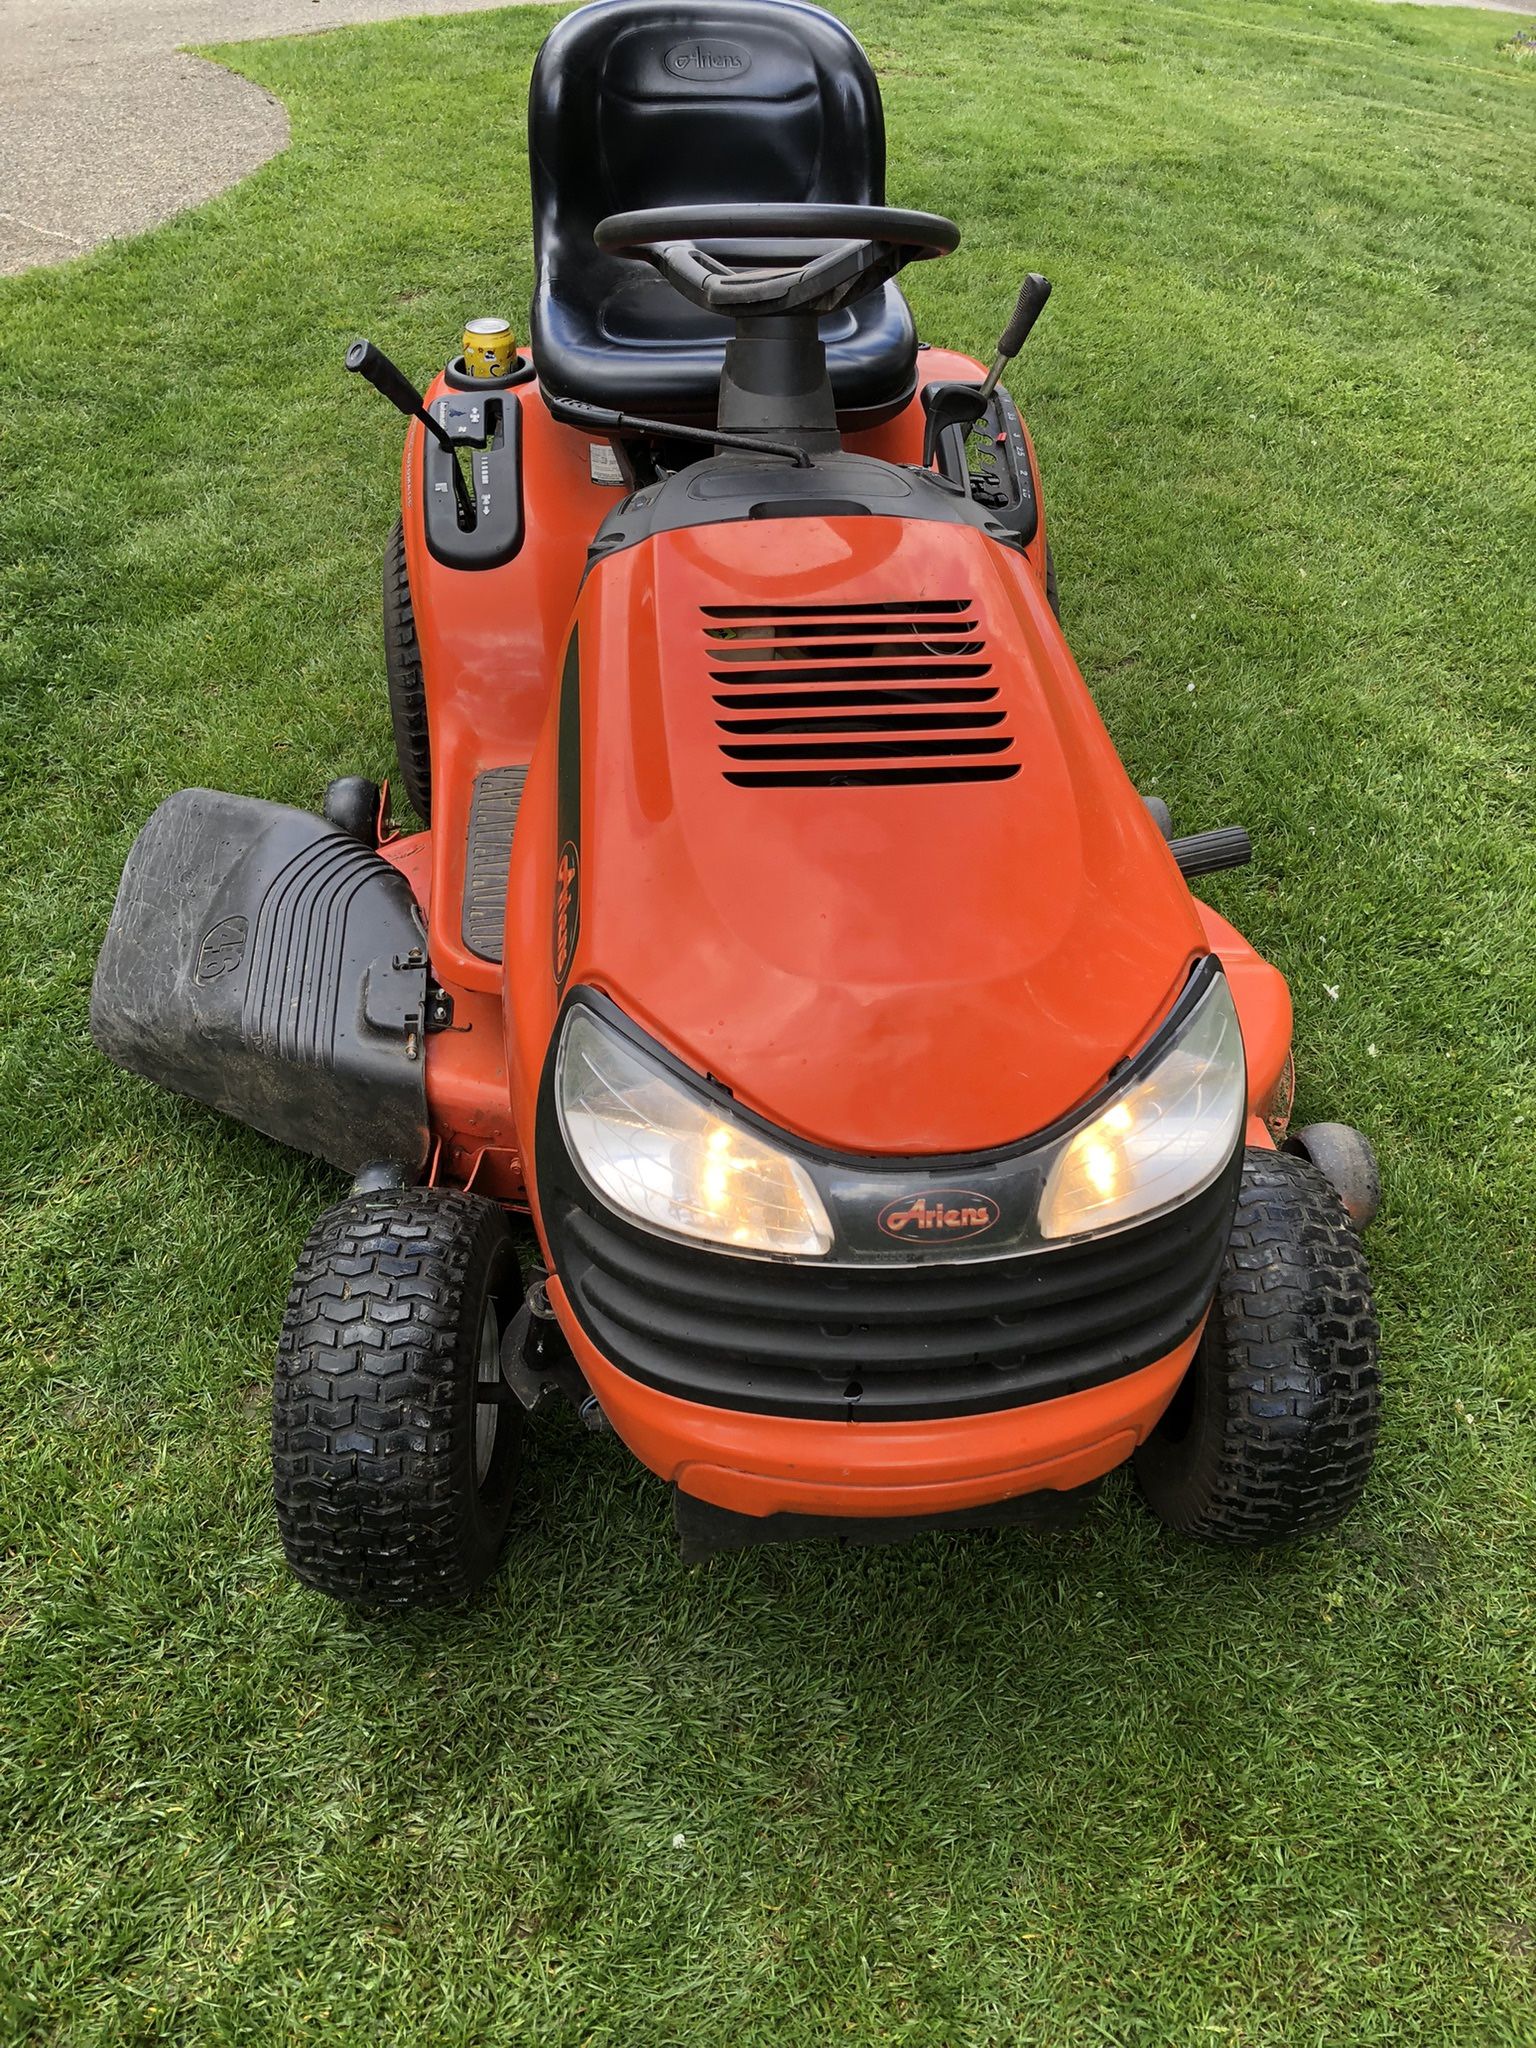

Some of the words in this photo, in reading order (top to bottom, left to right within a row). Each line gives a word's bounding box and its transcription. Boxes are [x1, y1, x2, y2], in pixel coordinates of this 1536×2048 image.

[675, 45, 742, 69] Ariens
[198, 923, 246, 979] 46
[886, 1198, 990, 1232] Ariens
